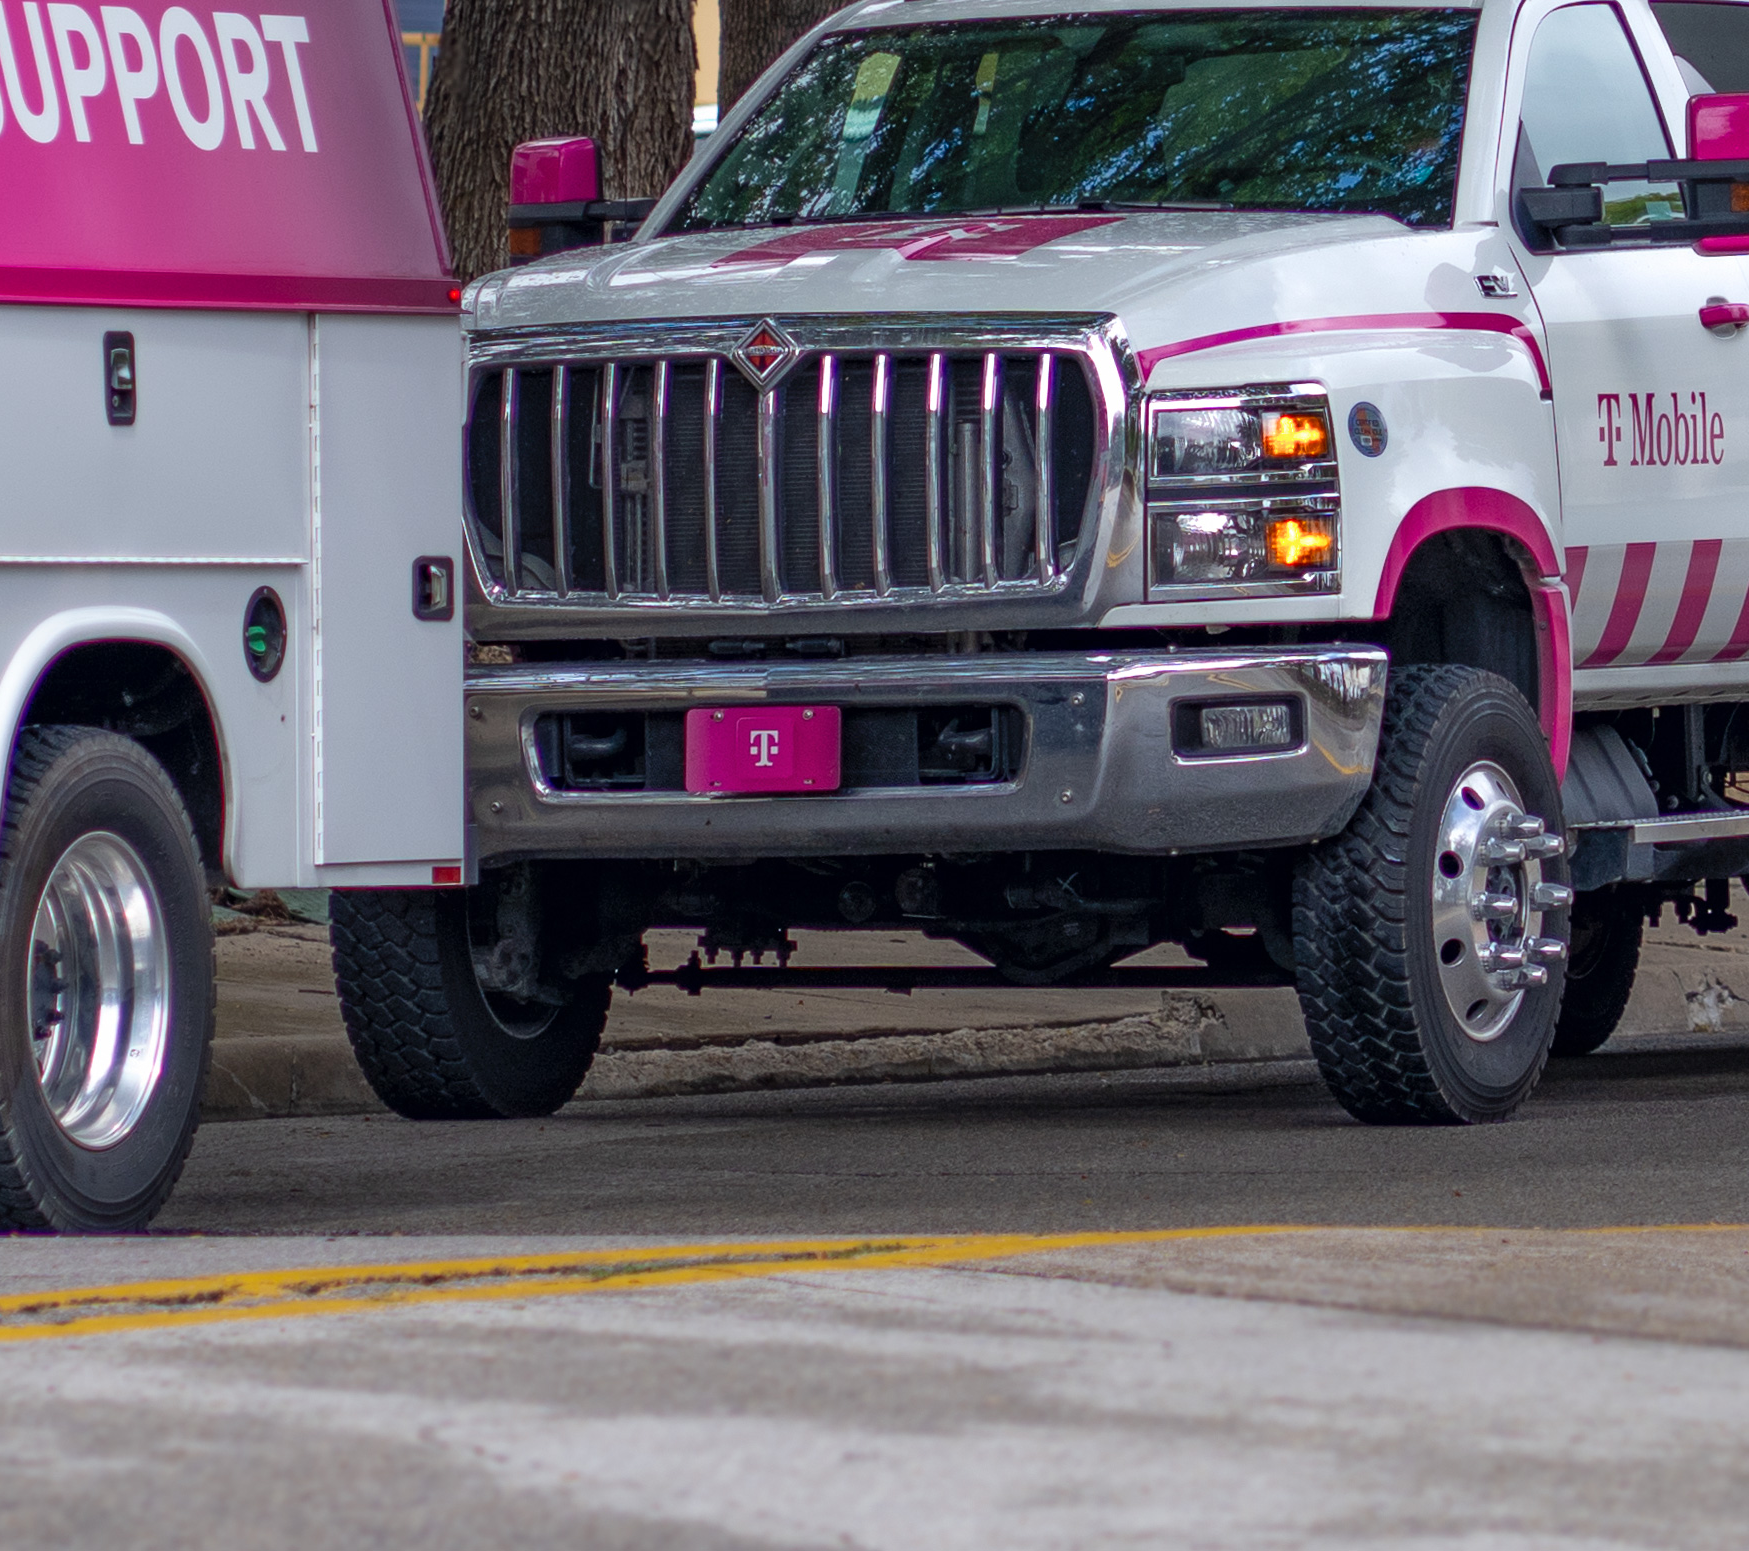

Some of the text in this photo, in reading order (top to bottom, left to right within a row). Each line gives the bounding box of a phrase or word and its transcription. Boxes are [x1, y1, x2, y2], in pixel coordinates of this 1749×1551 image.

[1597, 390, 1725, 467] T Mobile
[748, 729, 780, 767] T
